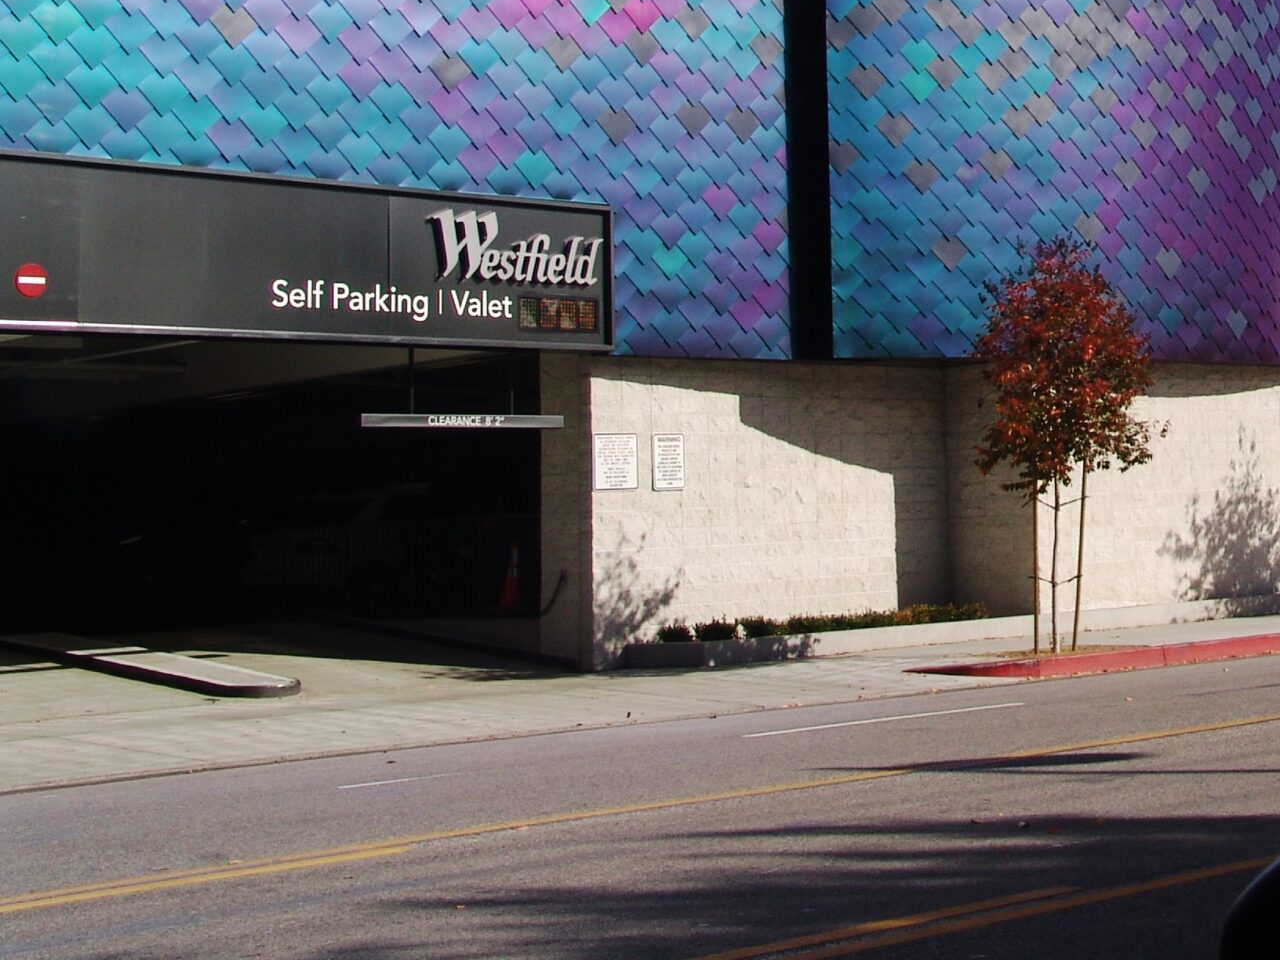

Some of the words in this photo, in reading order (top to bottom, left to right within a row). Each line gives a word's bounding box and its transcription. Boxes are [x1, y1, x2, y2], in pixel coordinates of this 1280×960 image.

[424, 208, 604, 286] Westfield
[271, 279, 324, 310] Self
[332, 282, 430, 322] Parking
[449, 289, 513, 319] Valet
[427, 415, 482, 426] CLEARANCE
